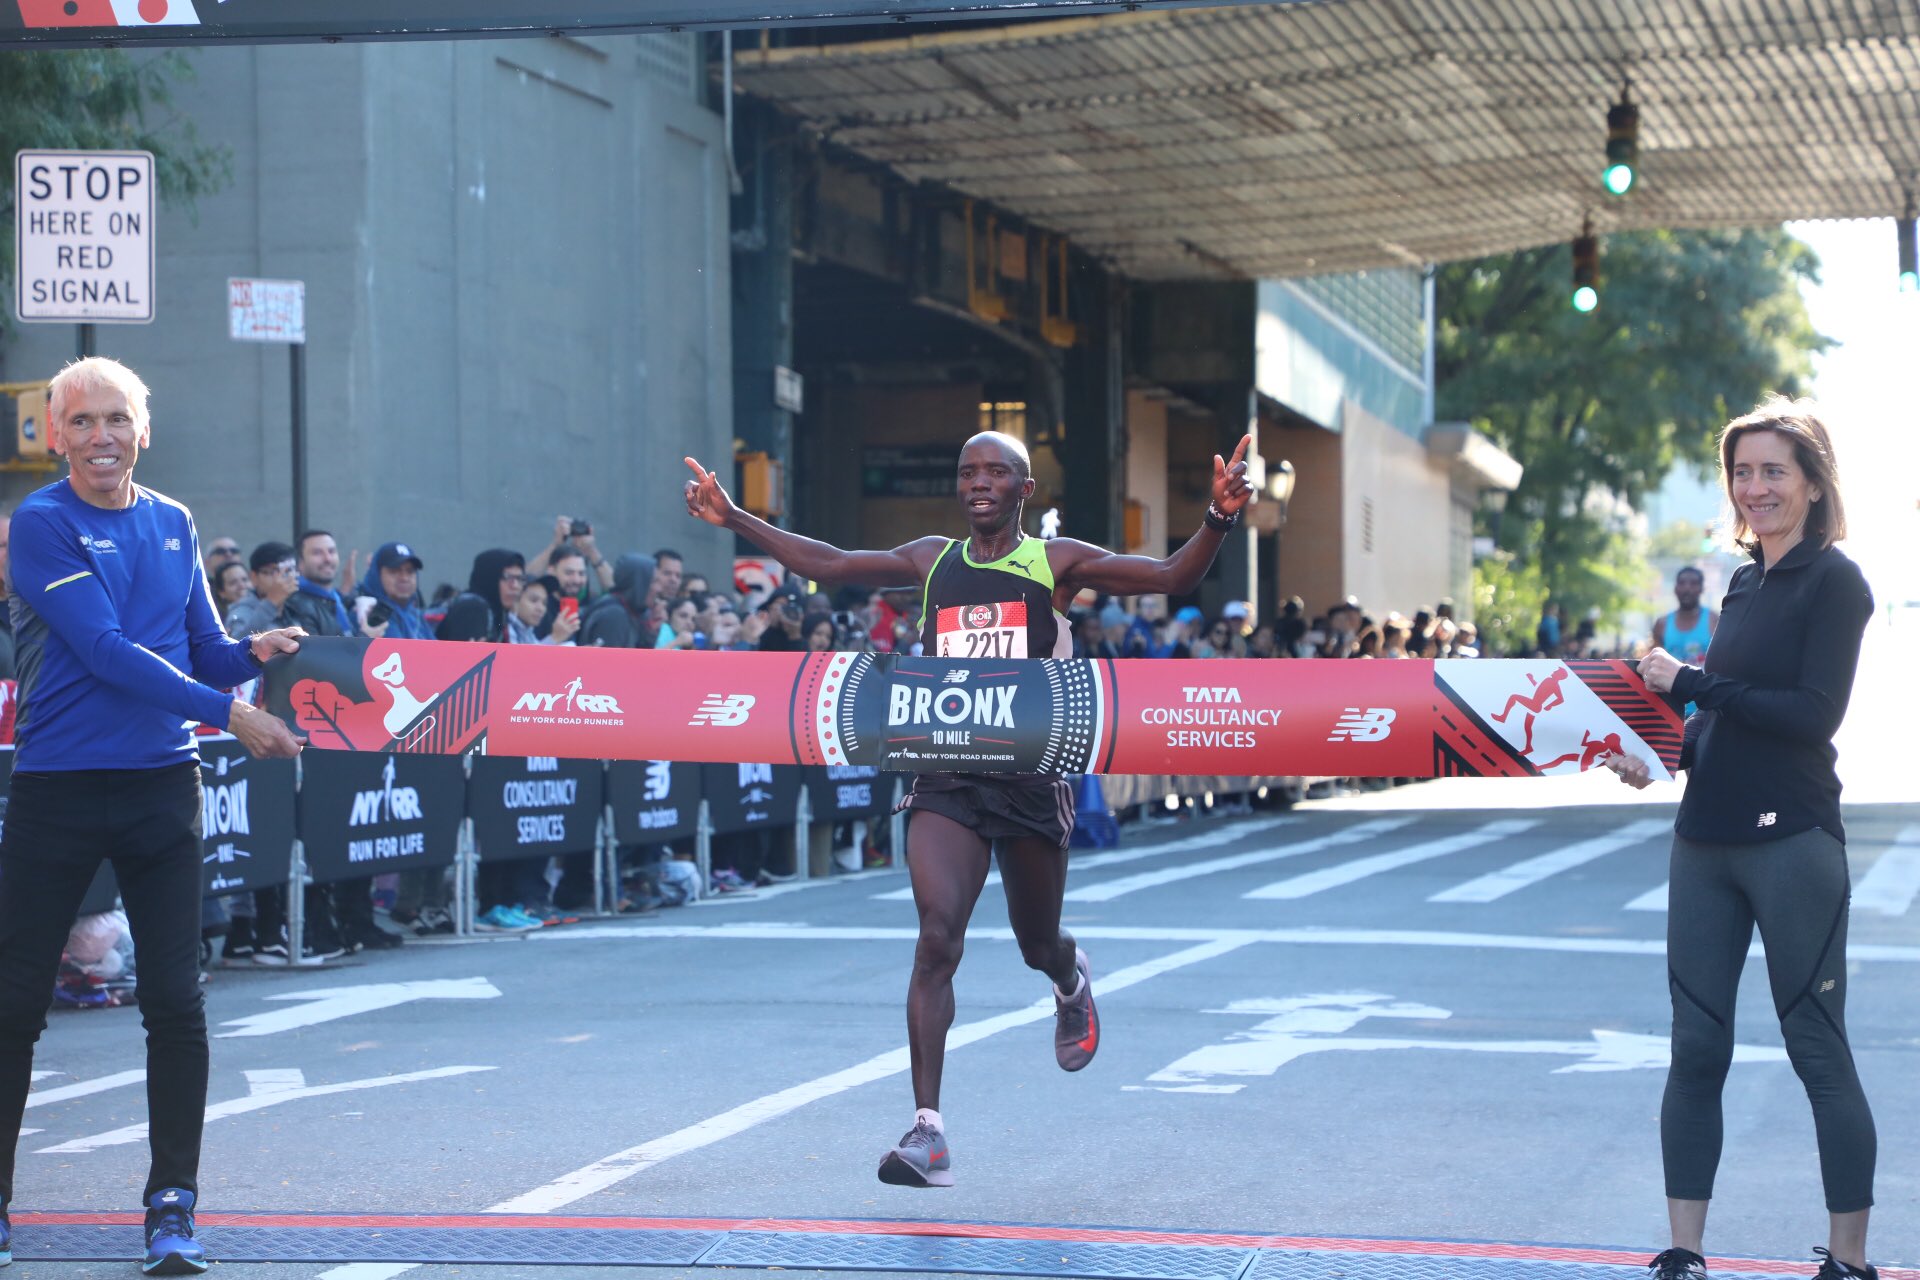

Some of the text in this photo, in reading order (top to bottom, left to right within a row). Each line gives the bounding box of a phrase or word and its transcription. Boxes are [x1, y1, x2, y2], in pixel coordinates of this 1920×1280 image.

[29, 165, 141, 202] STOP
[30, 211, 141, 236] HERE ON
[58, 246, 113, 270] RED
[32, 279, 140, 304] SIGNAL
[968, 610, 992, 622] BRONX
[942, 636, 949, 647] A
[965, 630, 1015, 658] 2217
[512, 689, 625, 714] NYRR
[888, 683, 1018, 729] BRONX
[1182, 686, 1242, 703] TATA
[510, 715, 624, 726] NEW YORK ROAD RUNNERS
[1140, 707, 1282, 726] CONSULTANCY
[932, 730, 971, 745] 10 MILE
[1166, 730, 1256, 748] SERVICES
[348, 832, 424, 863] RUN FOR LIFE
